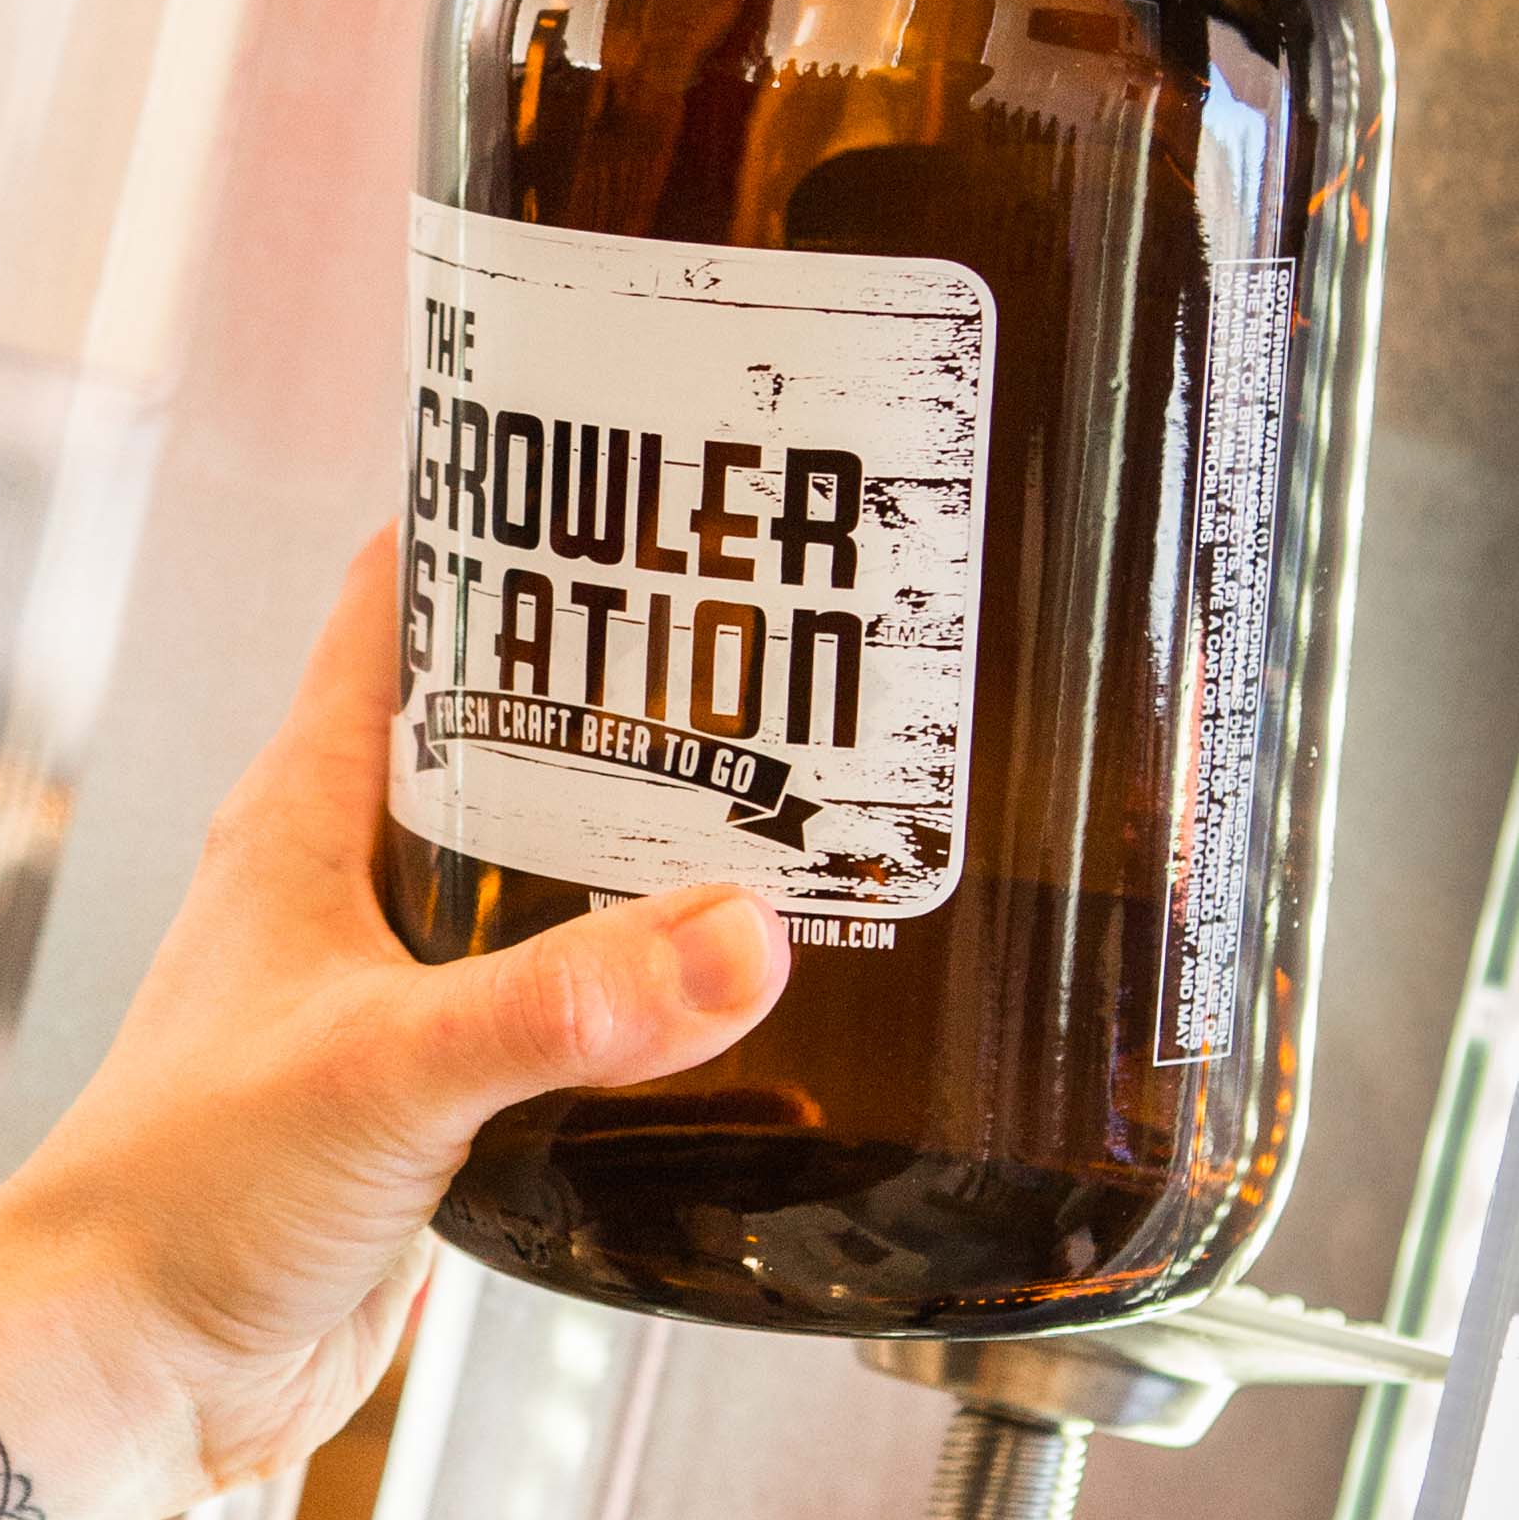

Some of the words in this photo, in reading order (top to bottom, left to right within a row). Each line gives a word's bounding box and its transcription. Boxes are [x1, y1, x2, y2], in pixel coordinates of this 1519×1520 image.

[1214, 271, 1232, 343] CAUSE
[1229, 271, 1247, 358] IMPAIRS
[1246, 270, 1262, 314] THE
[425, 297, 475, 382] THE
[1242, 317, 1258, 367] RISK
[1267, 269, 1289, 414] GOVERNMENT
[1207, 349, 1227, 426] HEALTH
[1224, 363, 1240, 421] YOUR
[1239, 372, 1254, 400] OF
[1218, 428, 1235, 506] ABILITY
[1234, 406, 1251, 467] BIRTH
[414, 385, 863, 590] GROWLER
[1215, 512, 1229, 541] TO
[1210, 546, 1226, 610] DRIVE
[407, 538, 863, 749] STATION
[1208, 614, 1221, 631] A
[1246, 557, 1265, 678] ACCORDING
[1205, 633, 1219, 678] CAR
[1211, 611, 1235, 765] CONSUMPTION
[1202, 682, 1215, 716] OR
[1243, 682, 1255, 711] TO
[435, 695, 490, 736] FRESH
[498, 699, 572, 748] CRAFT
[581, 715, 652, 767] BEER
[664, 733, 700, 779] TO
[710, 748, 757, 795] GO
[1194, 719, 1213, 817] OPERATE
[1239, 718, 1253, 755] THE
[1208, 768, 1223, 800] OF
[1231, 760, 1249, 860] SURGEON
[1199, 803, 1220, 921] ALCOHOLIC
[1180, 956, 1194, 999] AND
[1189, 924, 1211, 1050] BEVERAGES
[1216, 966, 1233, 1044] WOMEN
[1176, 1003, 1191, 1048] MAY
